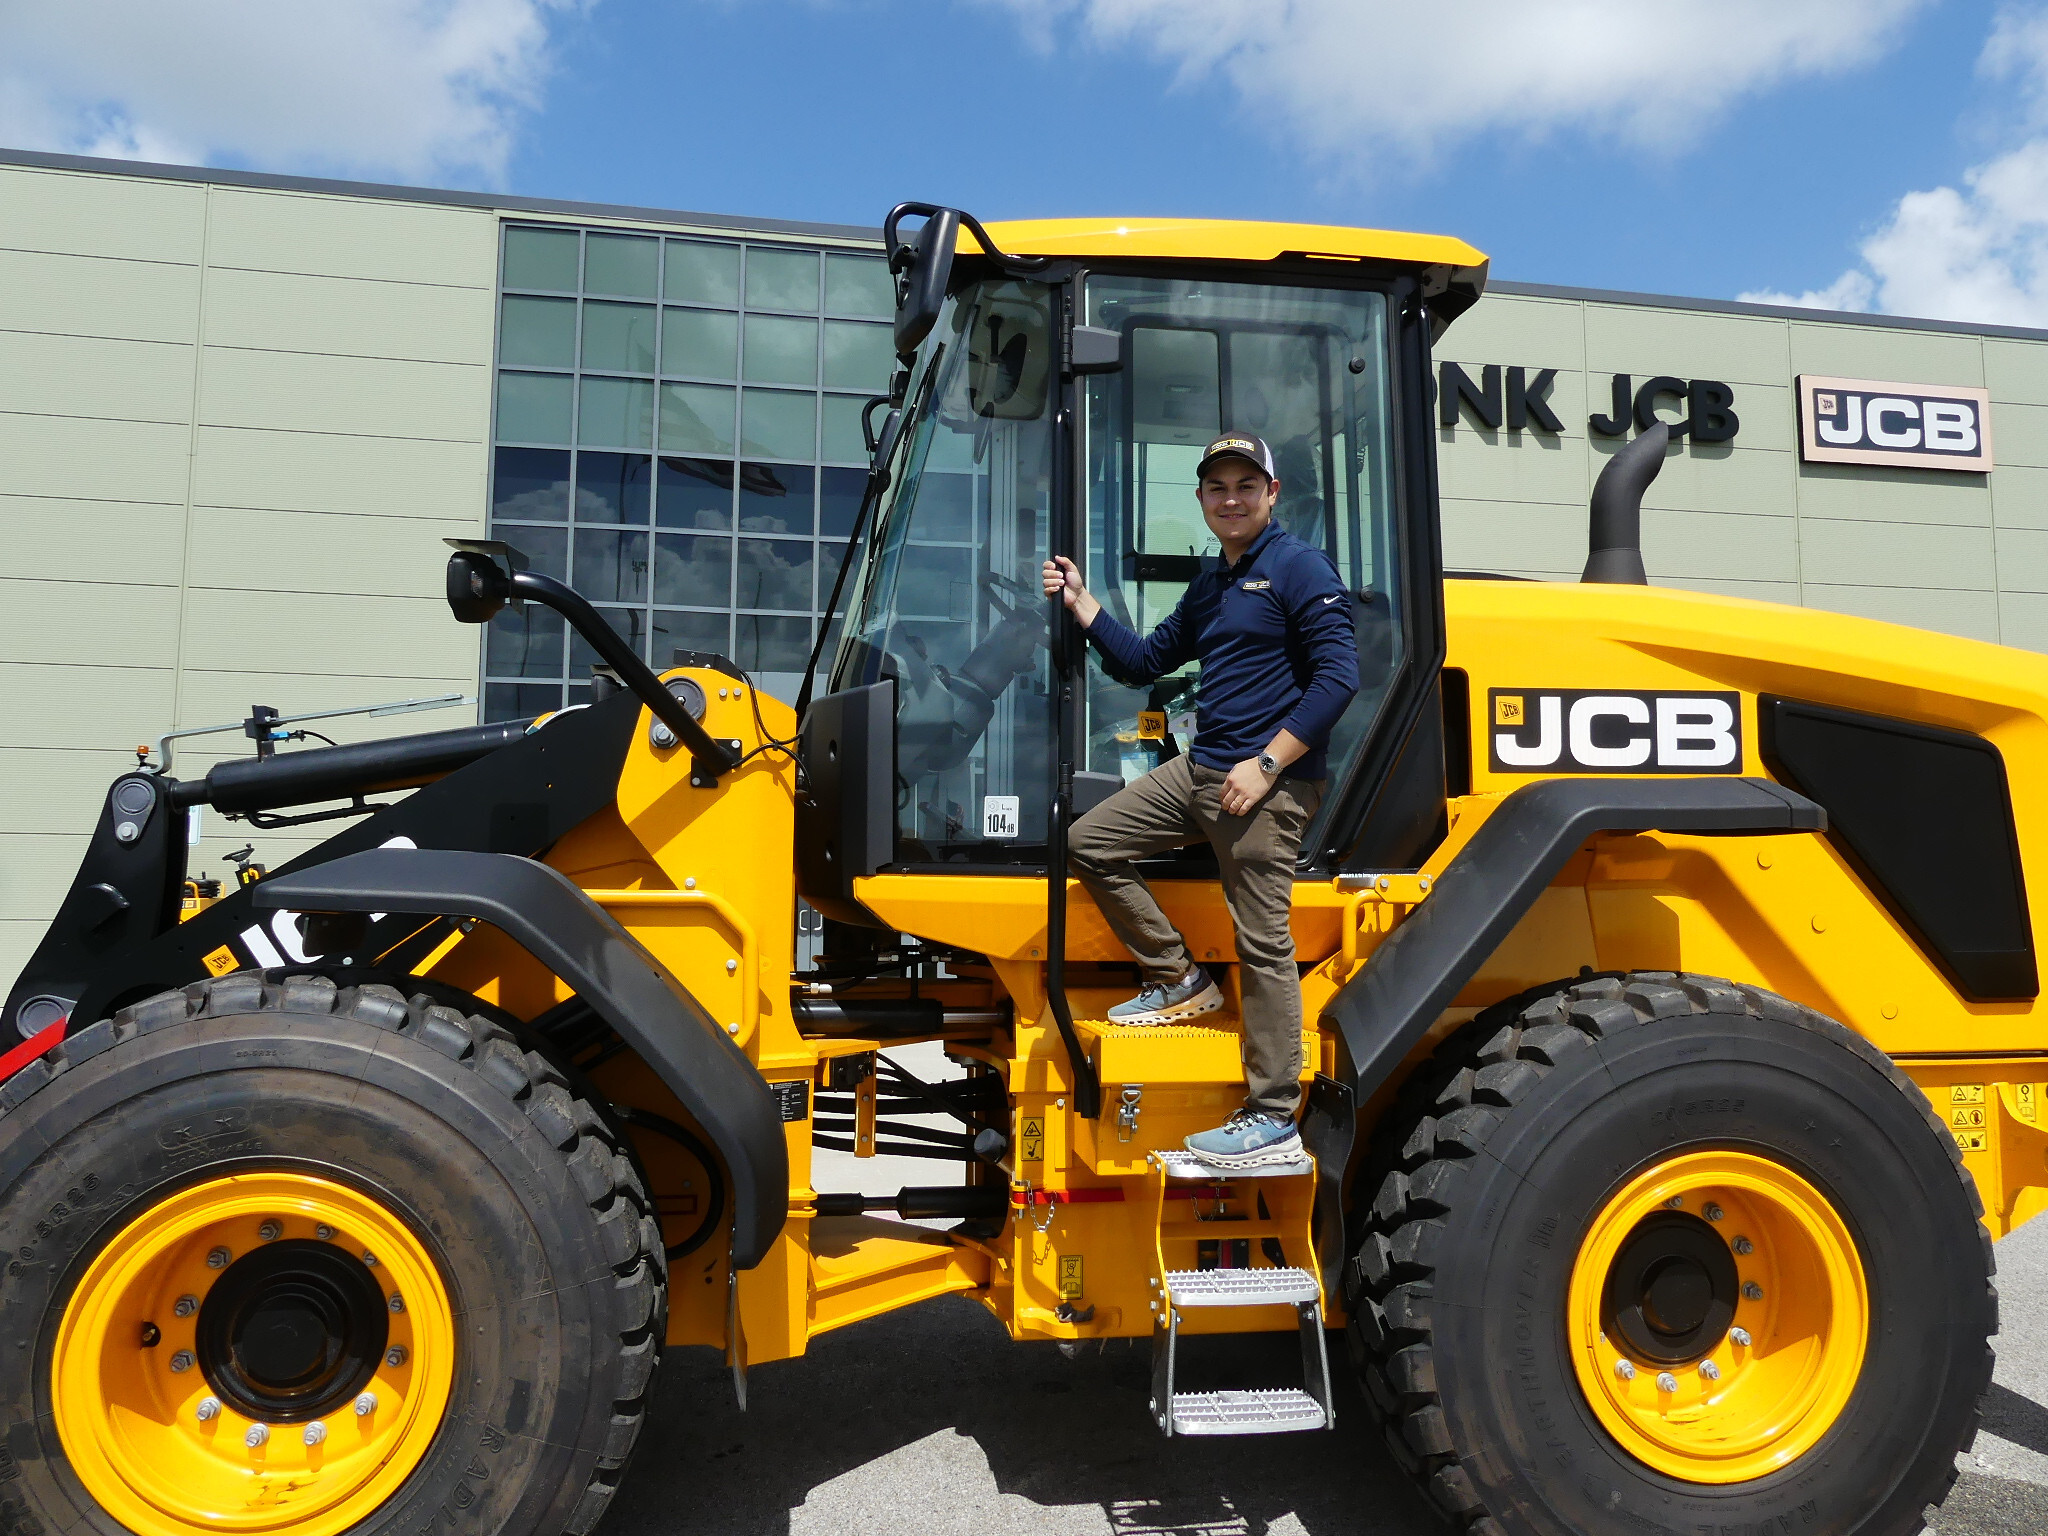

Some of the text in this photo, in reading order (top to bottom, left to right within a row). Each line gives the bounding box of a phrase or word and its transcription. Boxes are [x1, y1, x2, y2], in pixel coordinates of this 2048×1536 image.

[1432, 361, 1740, 441] NK JCB
[1819, 396, 1977, 451] JCB
[1503, 702, 1520, 717] JCB
[1144, 718, 1162, 732] JCB
[1496, 696, 1737, 767] JCB
[987, 814, 1014, 833] 104 dB
[215, 954, 231, 970] JCB
